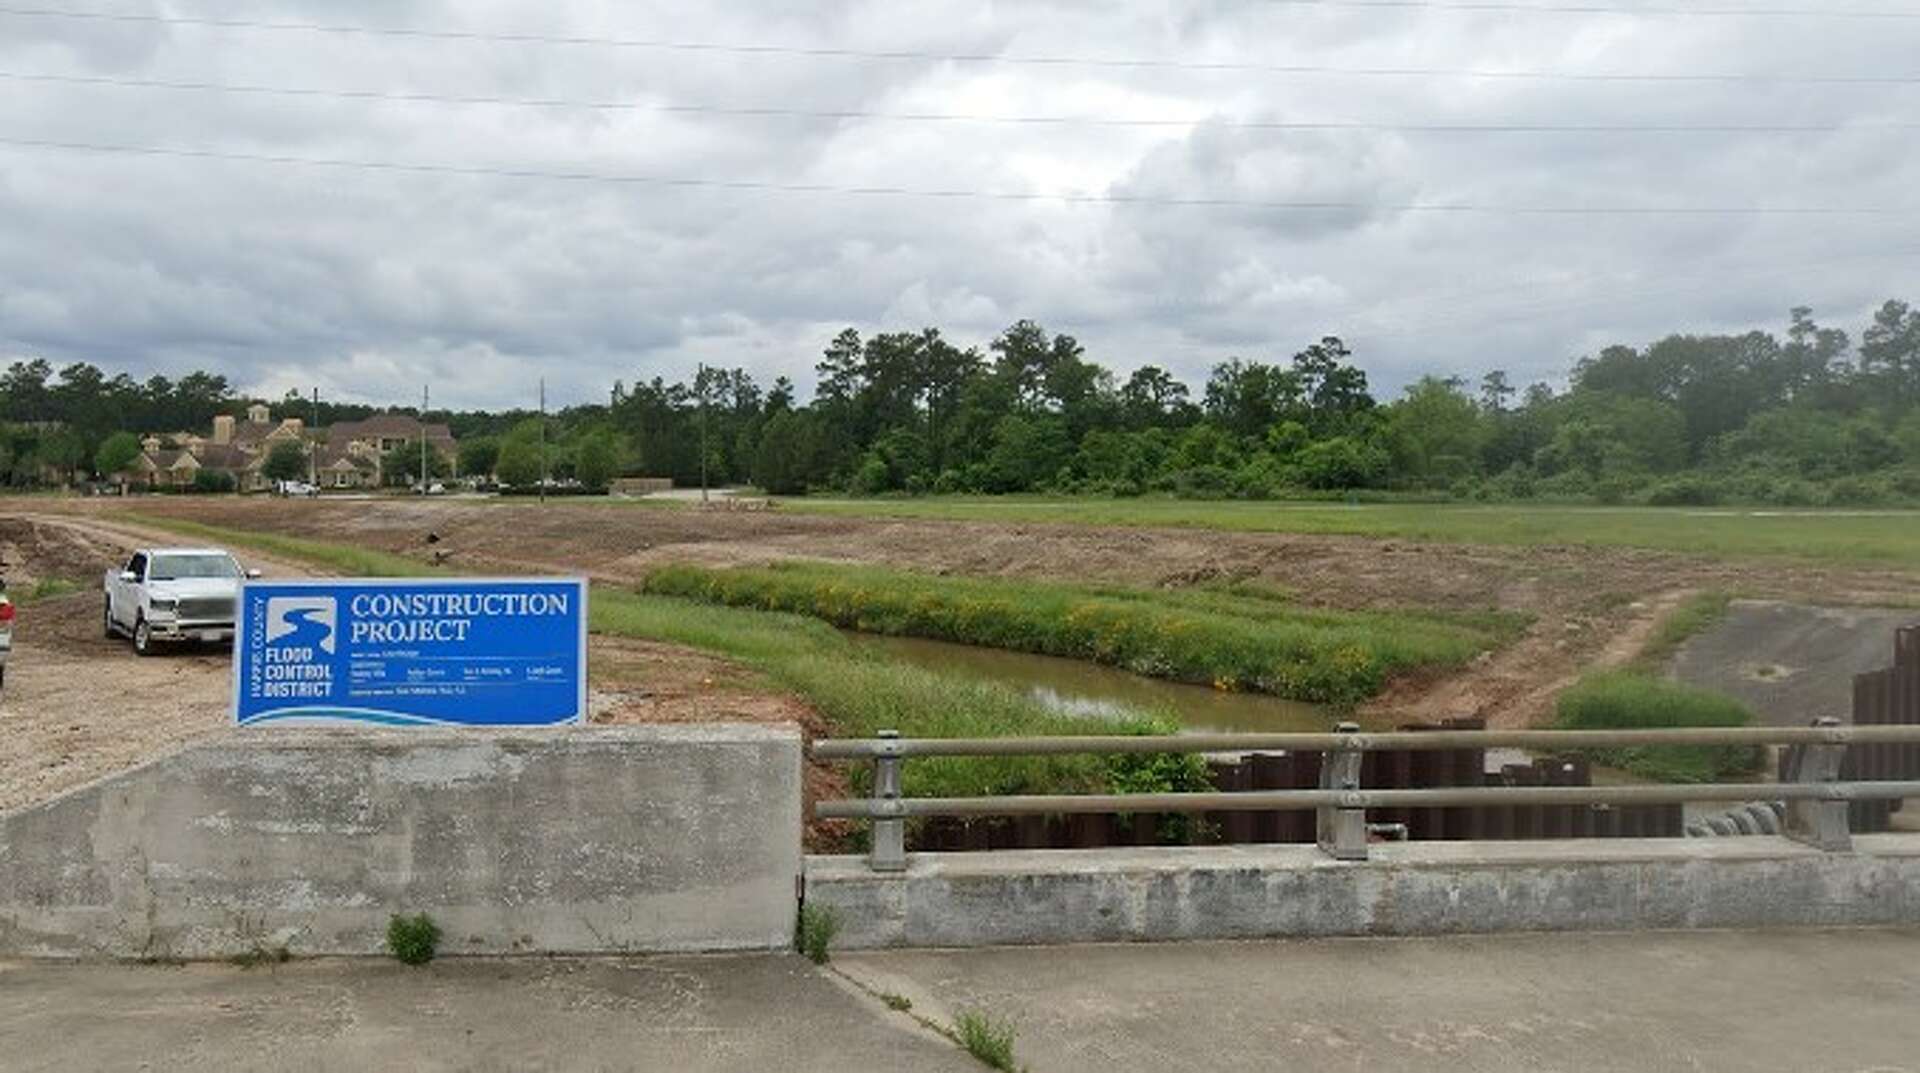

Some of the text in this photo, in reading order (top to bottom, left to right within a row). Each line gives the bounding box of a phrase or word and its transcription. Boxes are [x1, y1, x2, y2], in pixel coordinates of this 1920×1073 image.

[351, 593, 568, 618] CONSTRUCTION
[251, 597, 265, 649] COUNTY
[350, 619, 471, 644] PROJECT
[265, 647, 312, 662] FLOOD
[265, 664, 333, 680] CONTROL
[264, 682, 332, 697] DISTRICT
